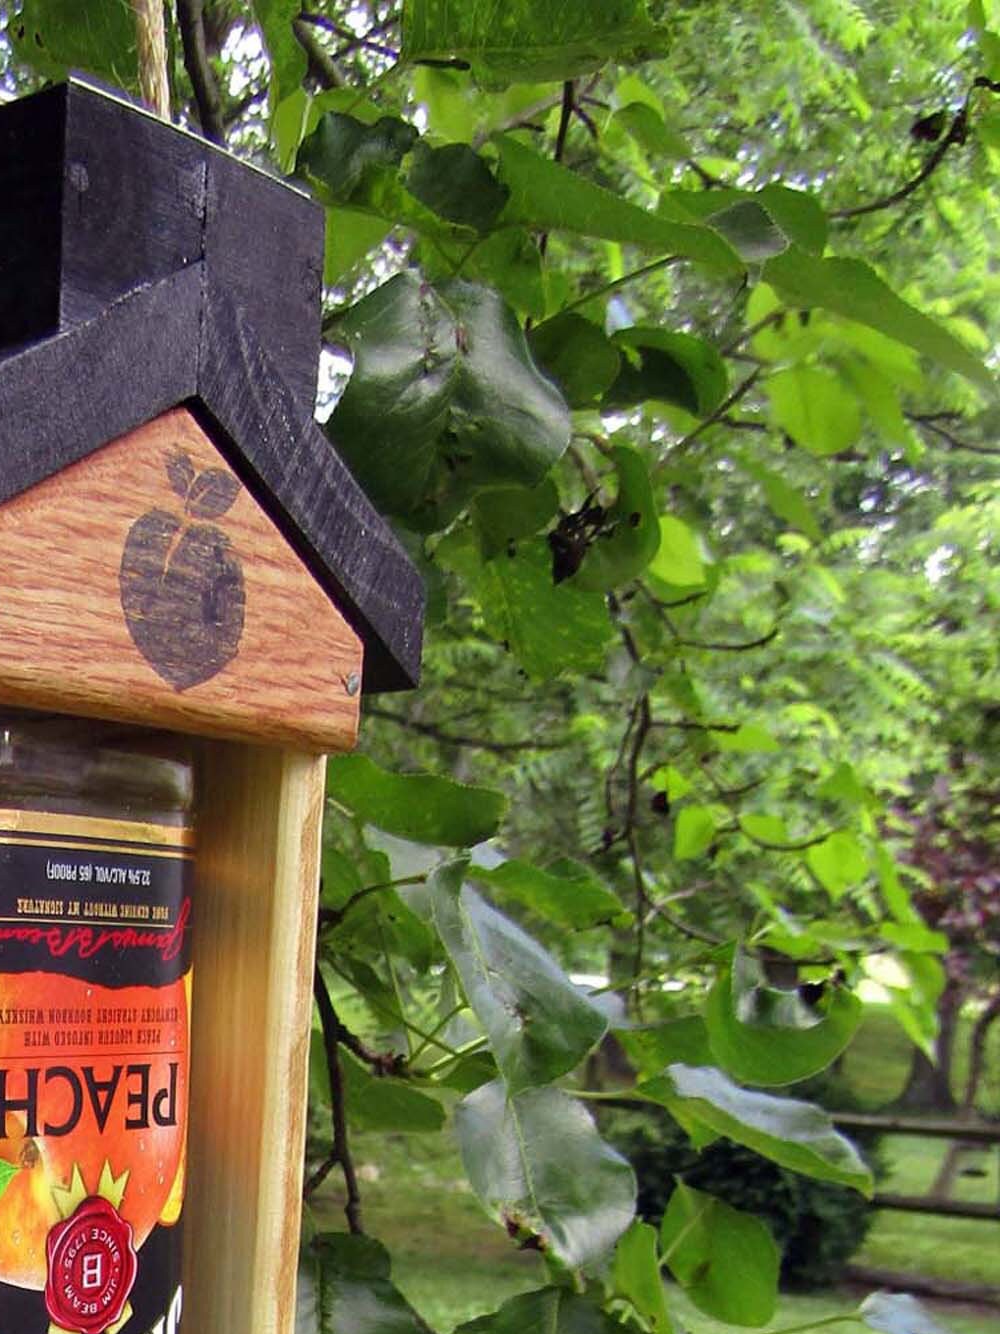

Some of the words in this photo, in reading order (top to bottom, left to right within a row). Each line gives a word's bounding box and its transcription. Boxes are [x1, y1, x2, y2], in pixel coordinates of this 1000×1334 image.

[46, 860, 77, 880] PROOF)
[95, 866, 127, 883] ALC/VOL
[17, 897, 63, 915] SIGNATURE
[67, 900, 80, 915] MY
[84, 901, 117, 918] WITHOUT
[48, 1008, 92, 1024] BOURBON
[96, 1008, 137, 1024] STRAIGHT
[24, 1031, 50, 1047] WITH
[54, 1031, 93, 1046] INFUSED
[64, 1233, 86, 1269] 1795
[90, 1228, 121, 1263] SINCE
[81, 1252, 103, 1289] B
[64, 1284, 98, 1314] BEAM
[101, 1278, 118, 1306] JIM
